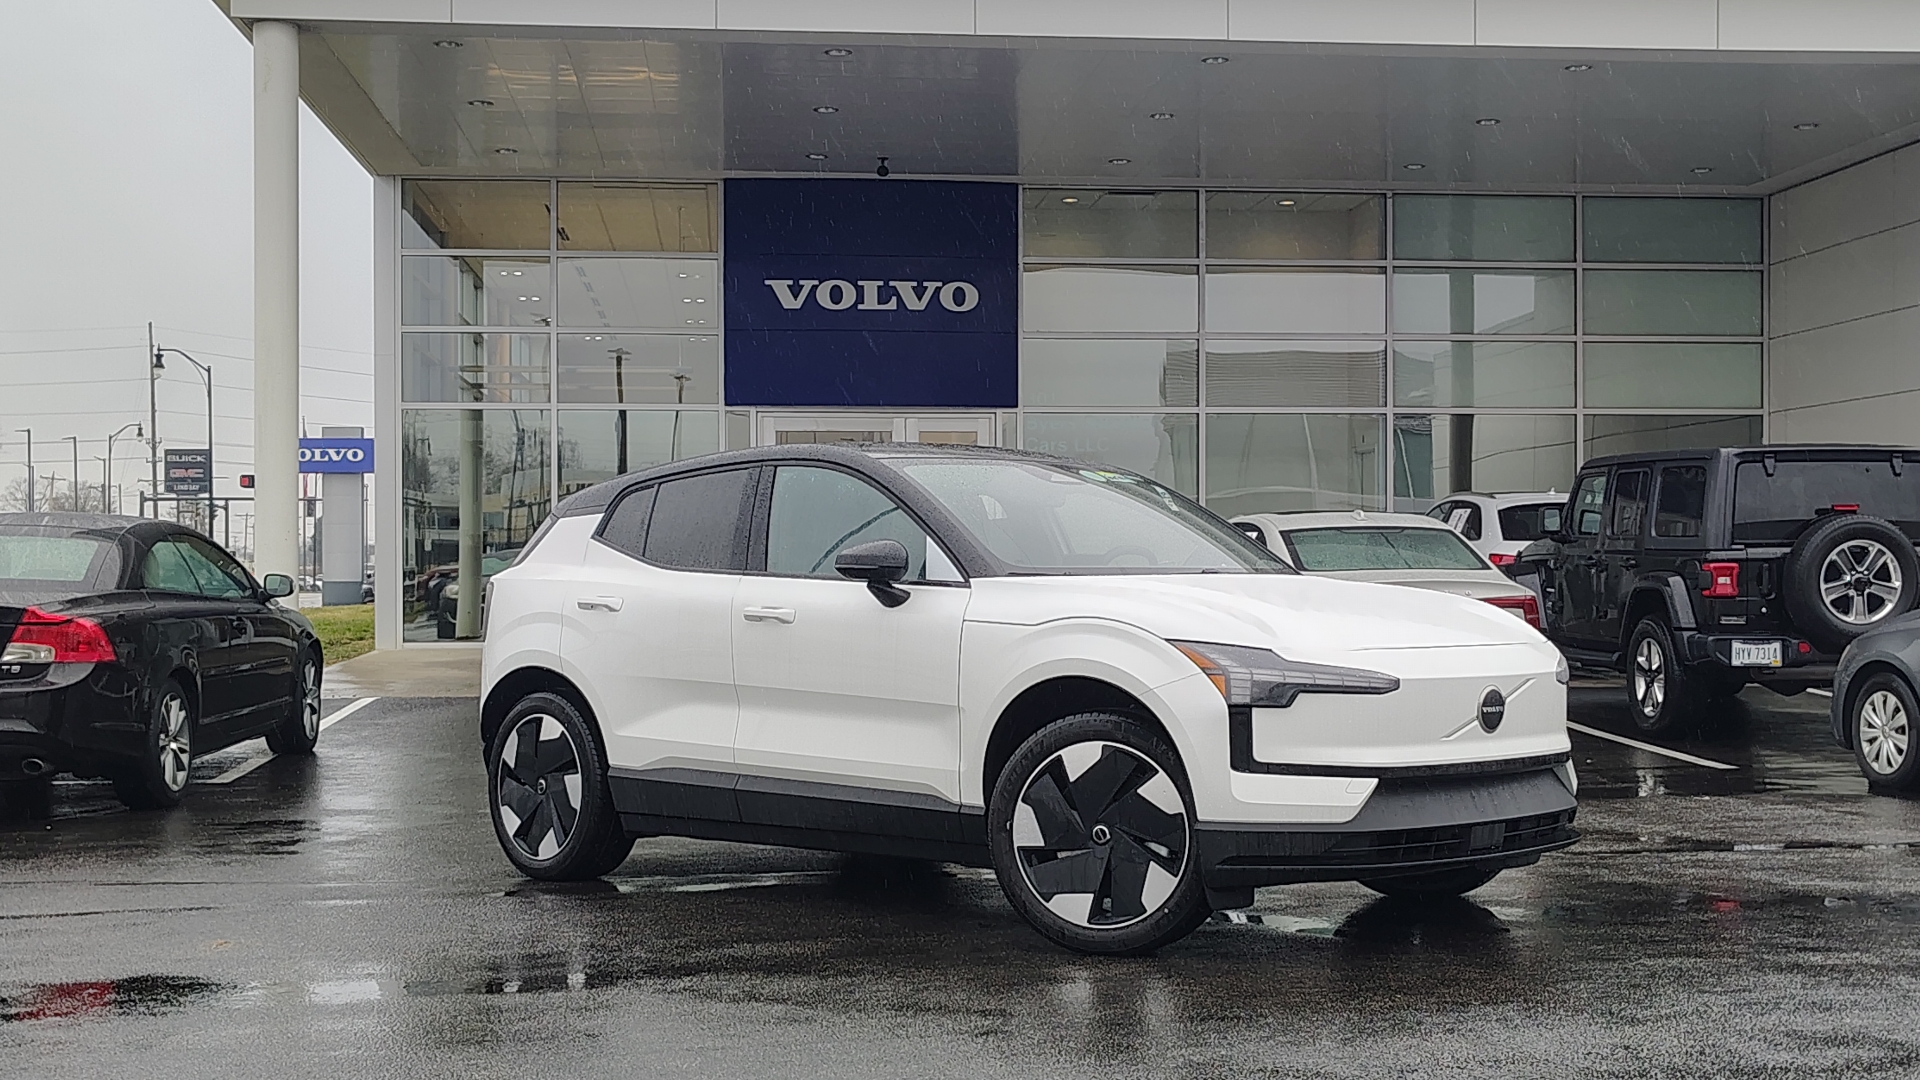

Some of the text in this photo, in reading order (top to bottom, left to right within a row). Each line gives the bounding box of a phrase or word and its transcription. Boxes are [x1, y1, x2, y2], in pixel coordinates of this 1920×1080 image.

[764, 279, 979, 312] VOLVO
[166, 454, 207, 462] BUICK
[298, 448, 365, 462] OLVO
[1734, 647, 1778, 661] HYV 7314
